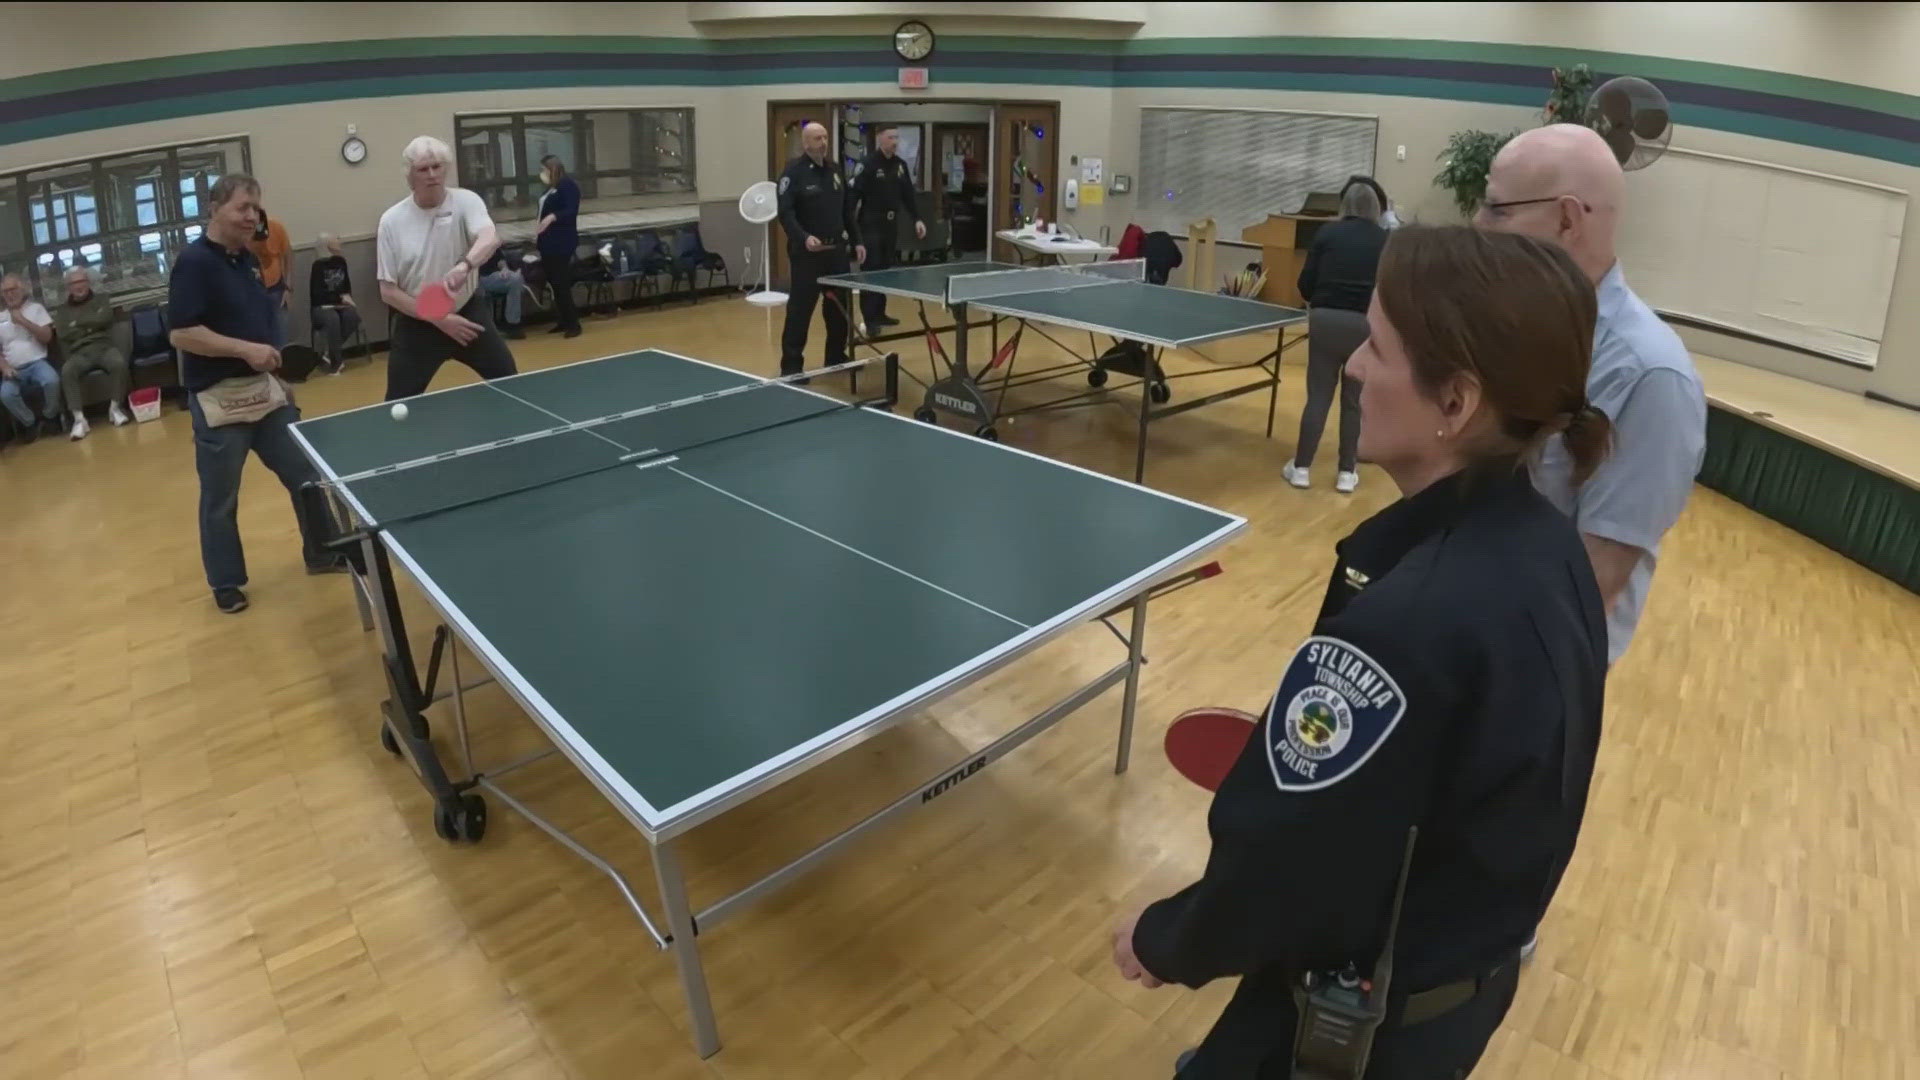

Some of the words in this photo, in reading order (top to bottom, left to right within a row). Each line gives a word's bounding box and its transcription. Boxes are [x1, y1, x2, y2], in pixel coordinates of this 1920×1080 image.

[935, 393, 976, 414] KETTLER
[1301, 688, 1328, 703] PEACE
[1307, 643, 1394, 709] SYLVANIA
[1314, 666, 1370, 709] TOWNSHIP
[1274, 739, 1318, 779] POLICE
[922, 756, 986, 804] KETTLER
